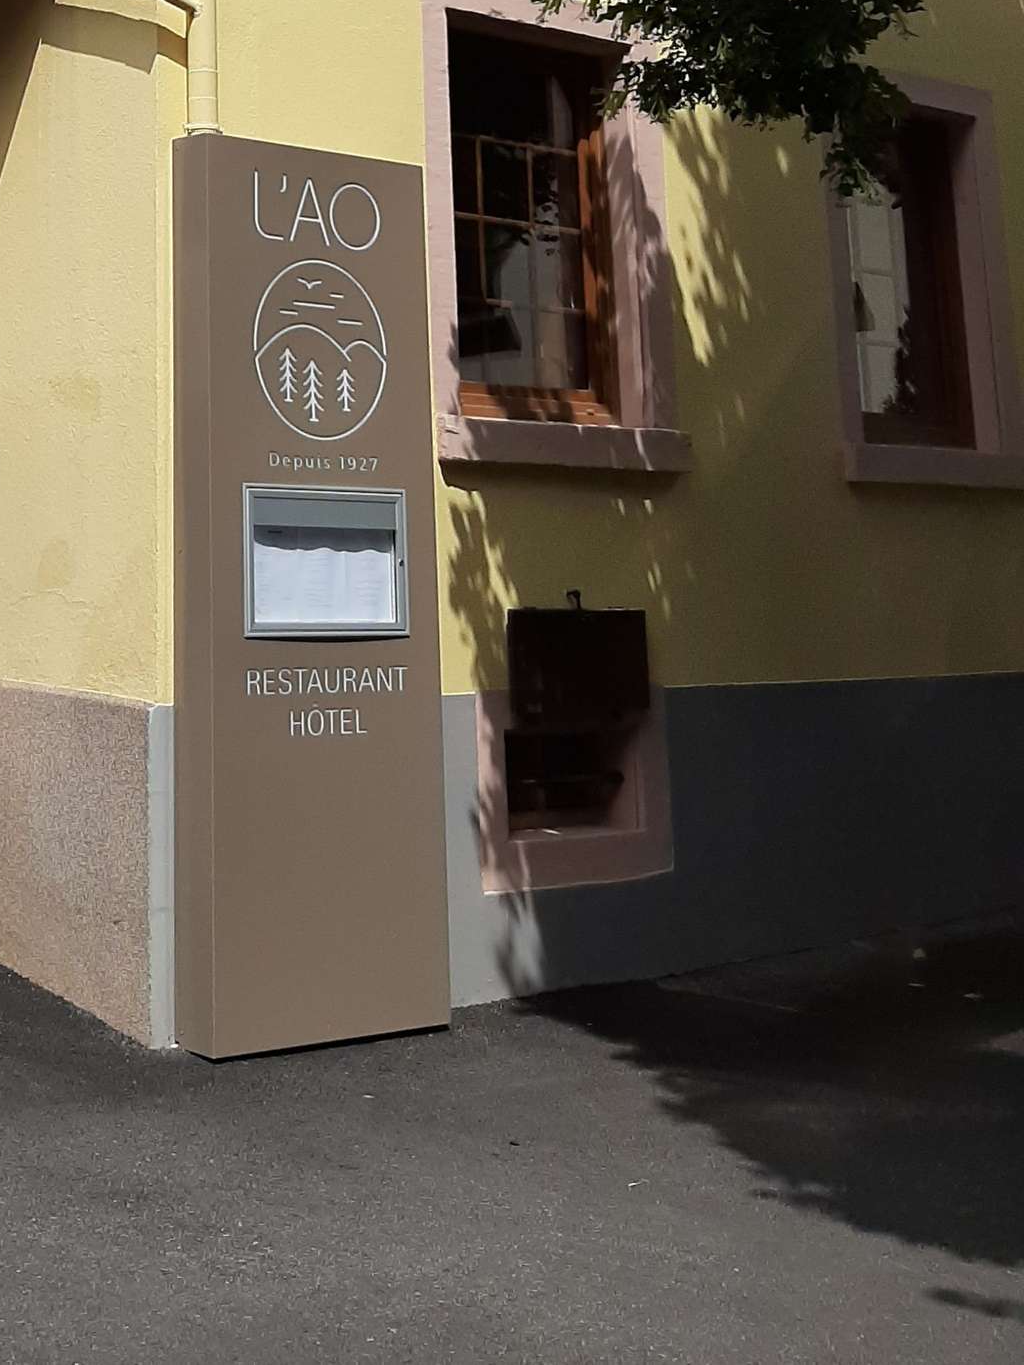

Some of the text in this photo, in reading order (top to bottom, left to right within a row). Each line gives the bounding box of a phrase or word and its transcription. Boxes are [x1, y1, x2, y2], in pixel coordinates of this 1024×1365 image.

[253, 170, 381, 251] L'AO
[268, 451, 378, 472] Depuis 1927
[246, 666, 408, 695] RESTAURANT
[289, 703, 368, 736] HÔTEL
